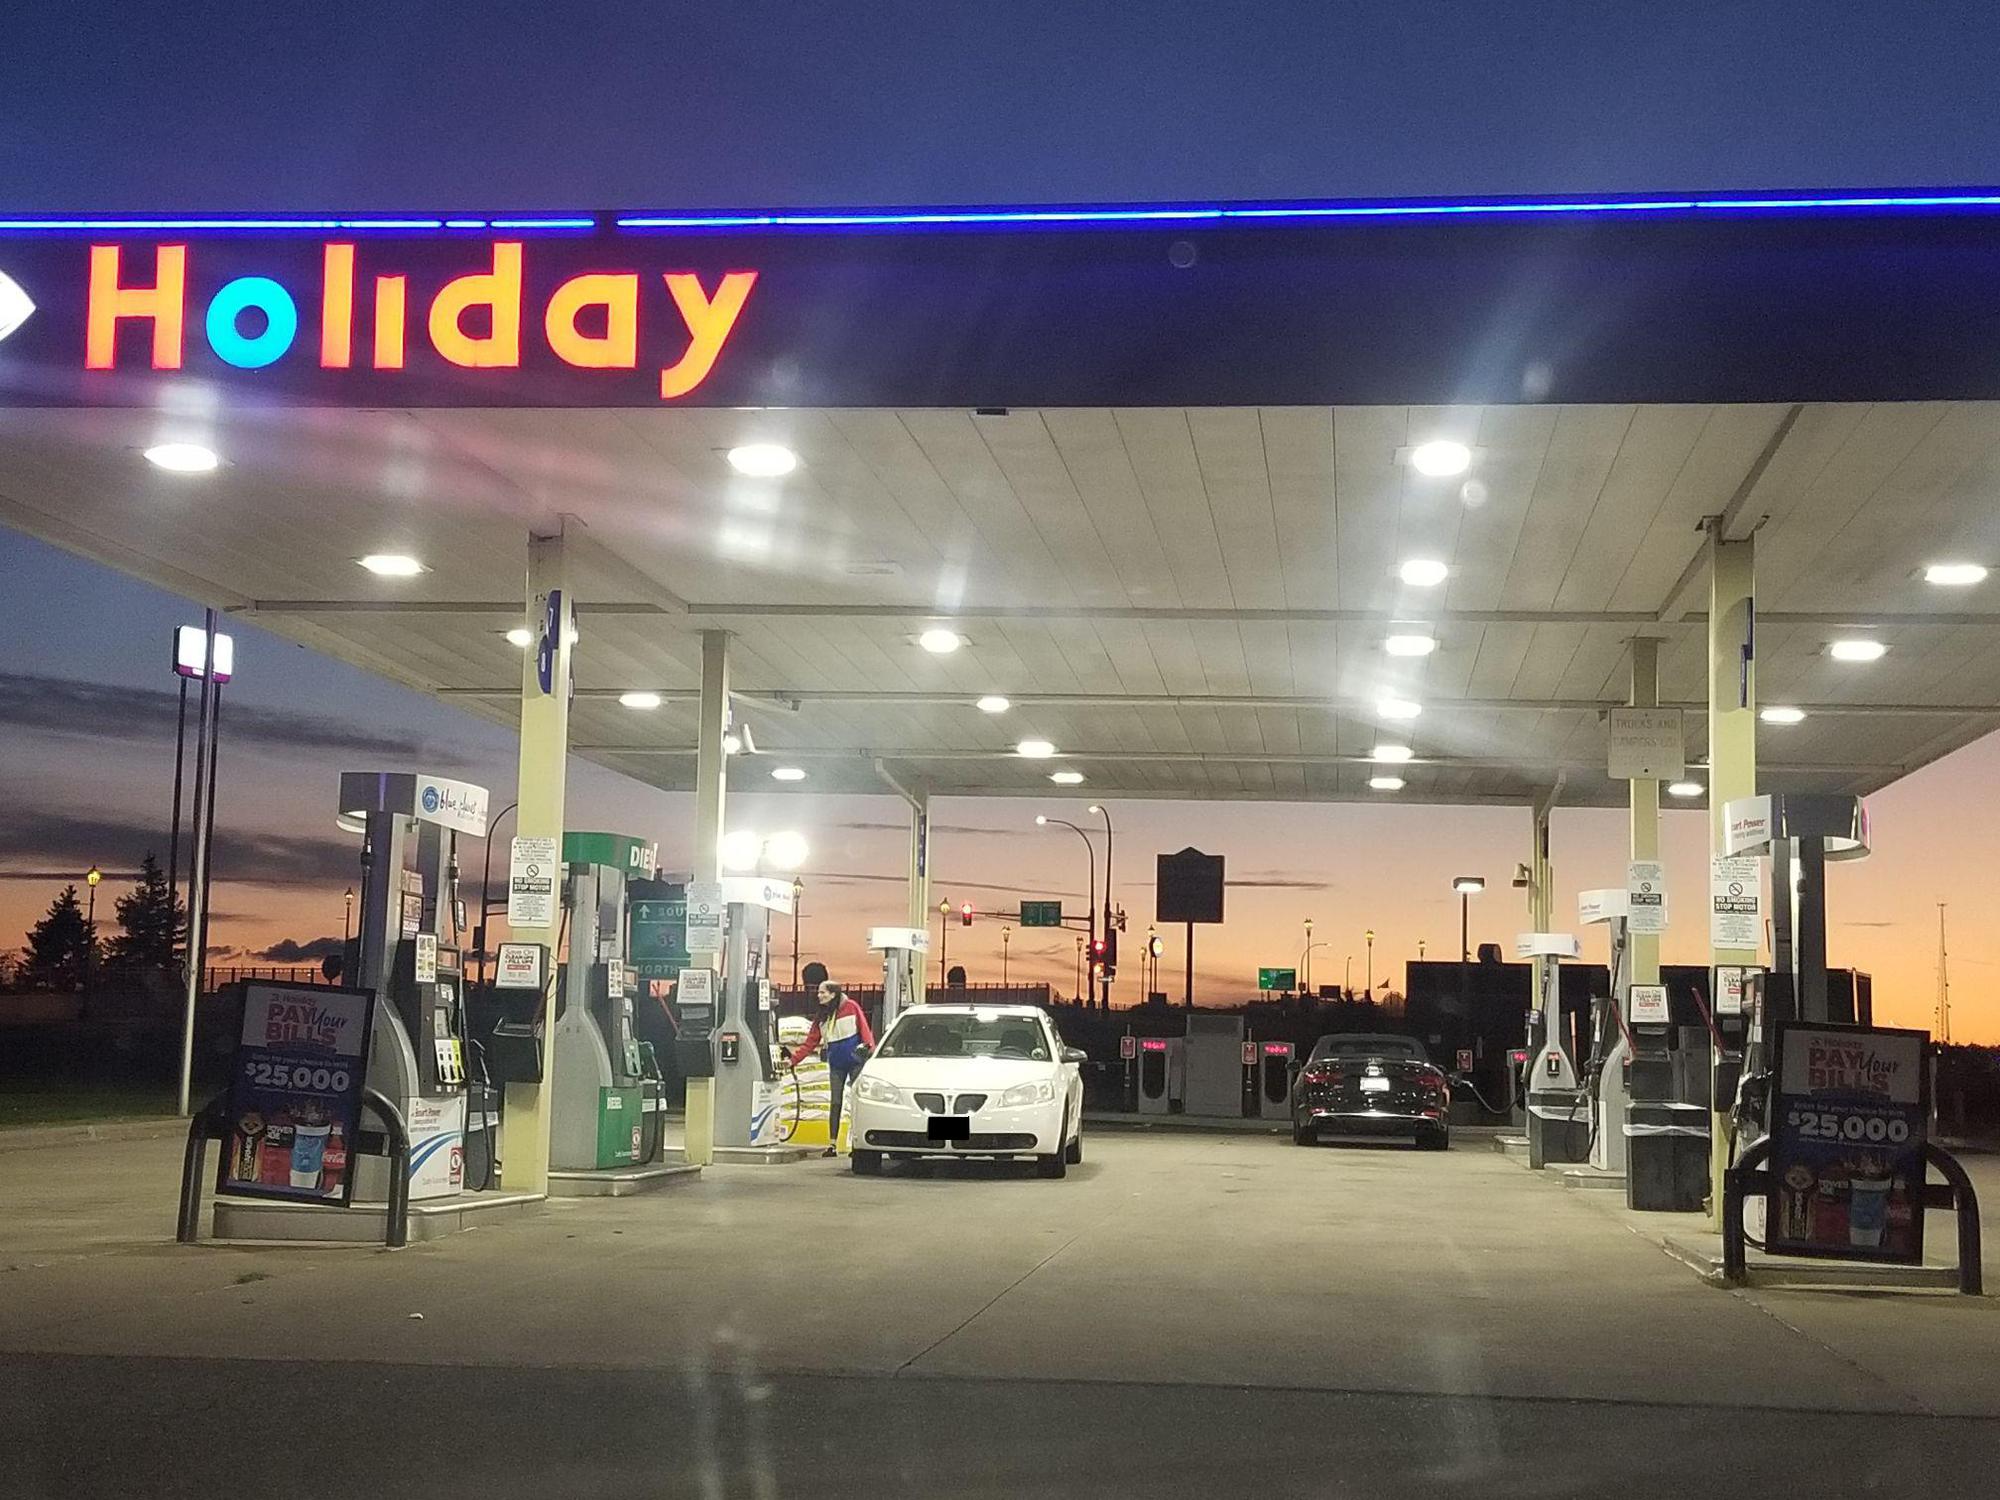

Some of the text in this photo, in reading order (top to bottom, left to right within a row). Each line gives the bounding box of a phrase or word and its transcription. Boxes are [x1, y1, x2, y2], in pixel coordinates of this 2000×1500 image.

[85, 241, 758, 398] Holiday
[658, 907, 688, 917] SOU
[1715, 903, 1732, 911] STOP
[1726, 896, 1757, 904] SMOKING
[267, 1003, 348, 1035] PAY Your
[265, 1022, 336, 1045] BILLS
[245, 1062, 350, 1092] $25,000
[1808, 1048, 1899, 1080] PAY Your
[1808, 1068, 1890, 1092] BILLS
[1788, 1111, 1909, 1143] $25,000
